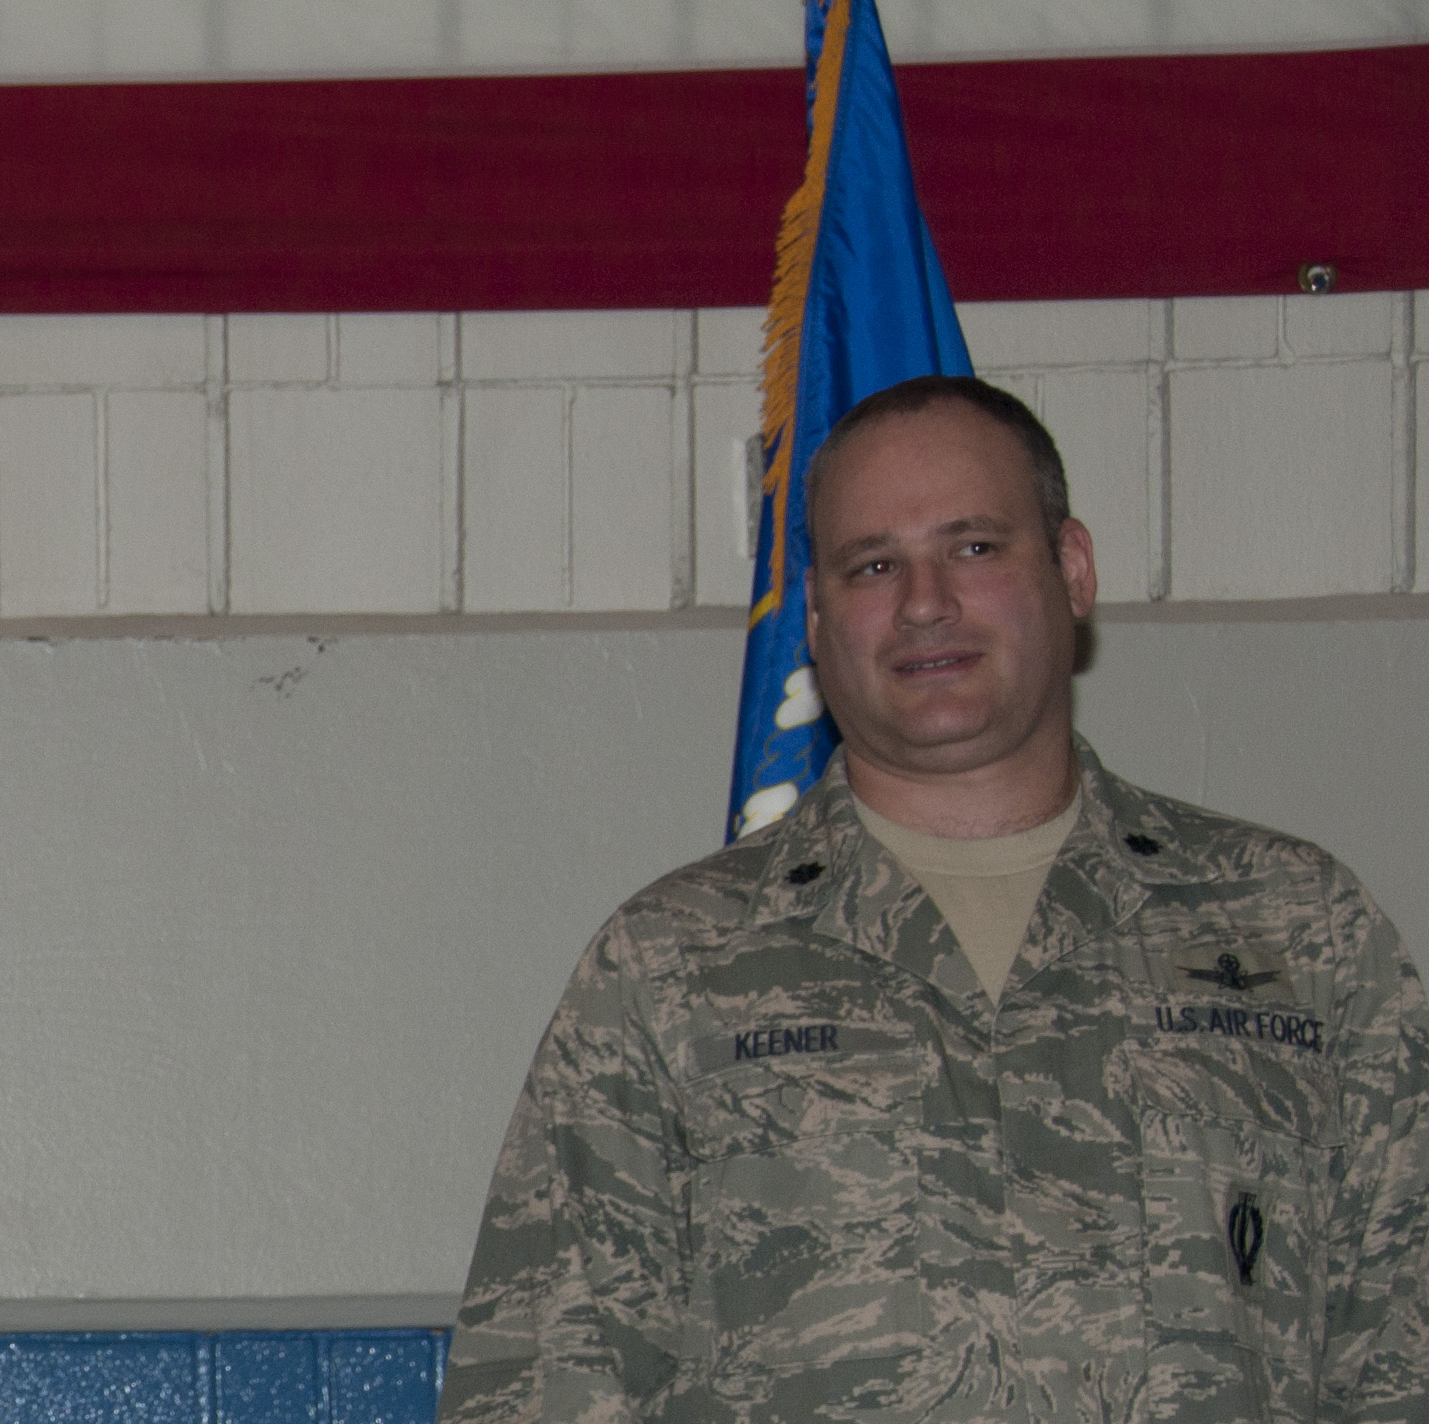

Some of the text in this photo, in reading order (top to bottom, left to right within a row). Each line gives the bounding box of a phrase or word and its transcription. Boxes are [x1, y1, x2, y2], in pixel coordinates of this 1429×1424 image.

[734, 1024, 838, 1061] KEENER
[1208, 1007, 1251, 1037] AIR
[1255, 1012, 1324, 1053] FORCE
